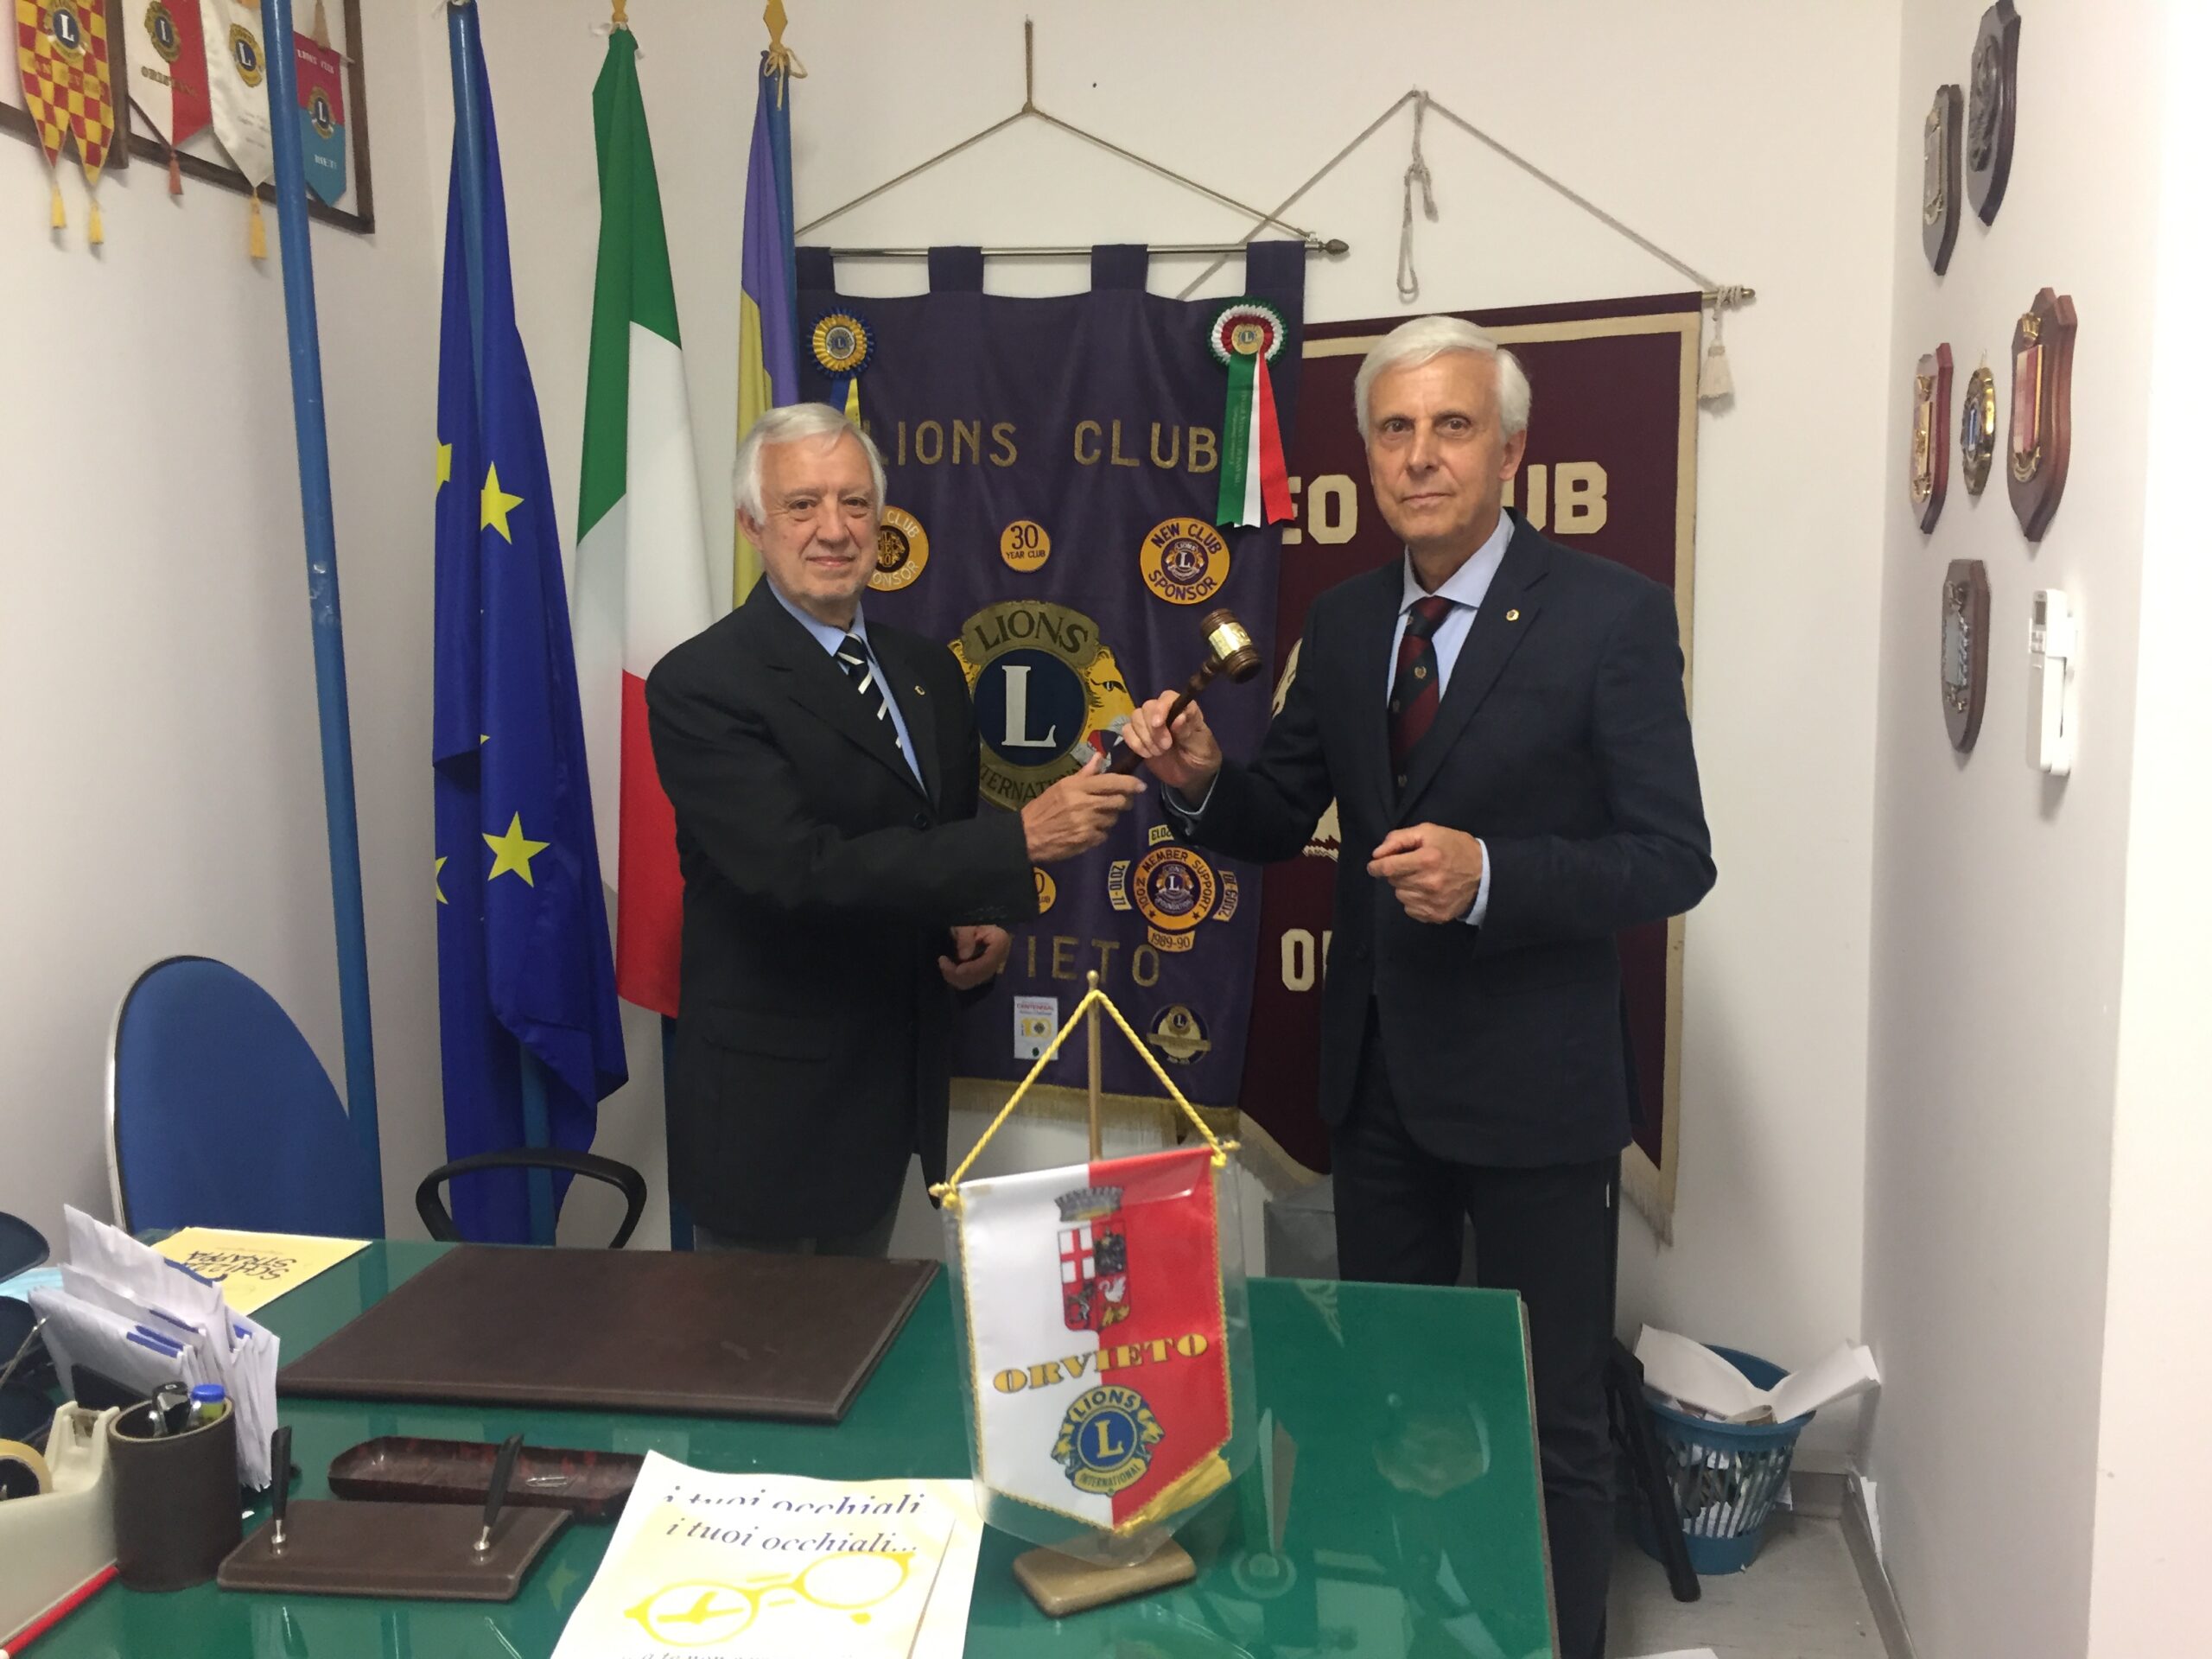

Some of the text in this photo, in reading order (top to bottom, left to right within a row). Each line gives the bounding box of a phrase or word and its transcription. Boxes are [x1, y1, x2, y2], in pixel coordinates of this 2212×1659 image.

[1073, 419, 1218, 474] CLUB
[887, 510, 920, 537] CLUB
[1010, 524, 1039, 550] 30
[1151, 522, 1223, 555] NEW CLUB
[1006, 550, 1046, 559] YEAR CLUB
[1179, 551, 1191, 568] L
[871, 560, 919, 587] ONSOR
[1148, 569, 1217, 601] SPONSOR
[975, 609, 1089, 654] LIONS
[1001, 664, 1057, 747] L
[1109, 865, 1126, 906] 2010-11
[1141, 849, 1189, 874] MEMBER
[1192, 860, 1213, 912] SUPPORT
[1168, 875, 1179, 891] L
[1152, 932, 1191, 949] 1989-90
[993, 1332, 1209, 1394] ORVIETO
[1072, 1389, 1137, 1417] LIONS
[1095, 1419, 1125, 1459] L
[665, 1517, 686, 1536] i
[687, 1521, 760, 1548] tuoi
